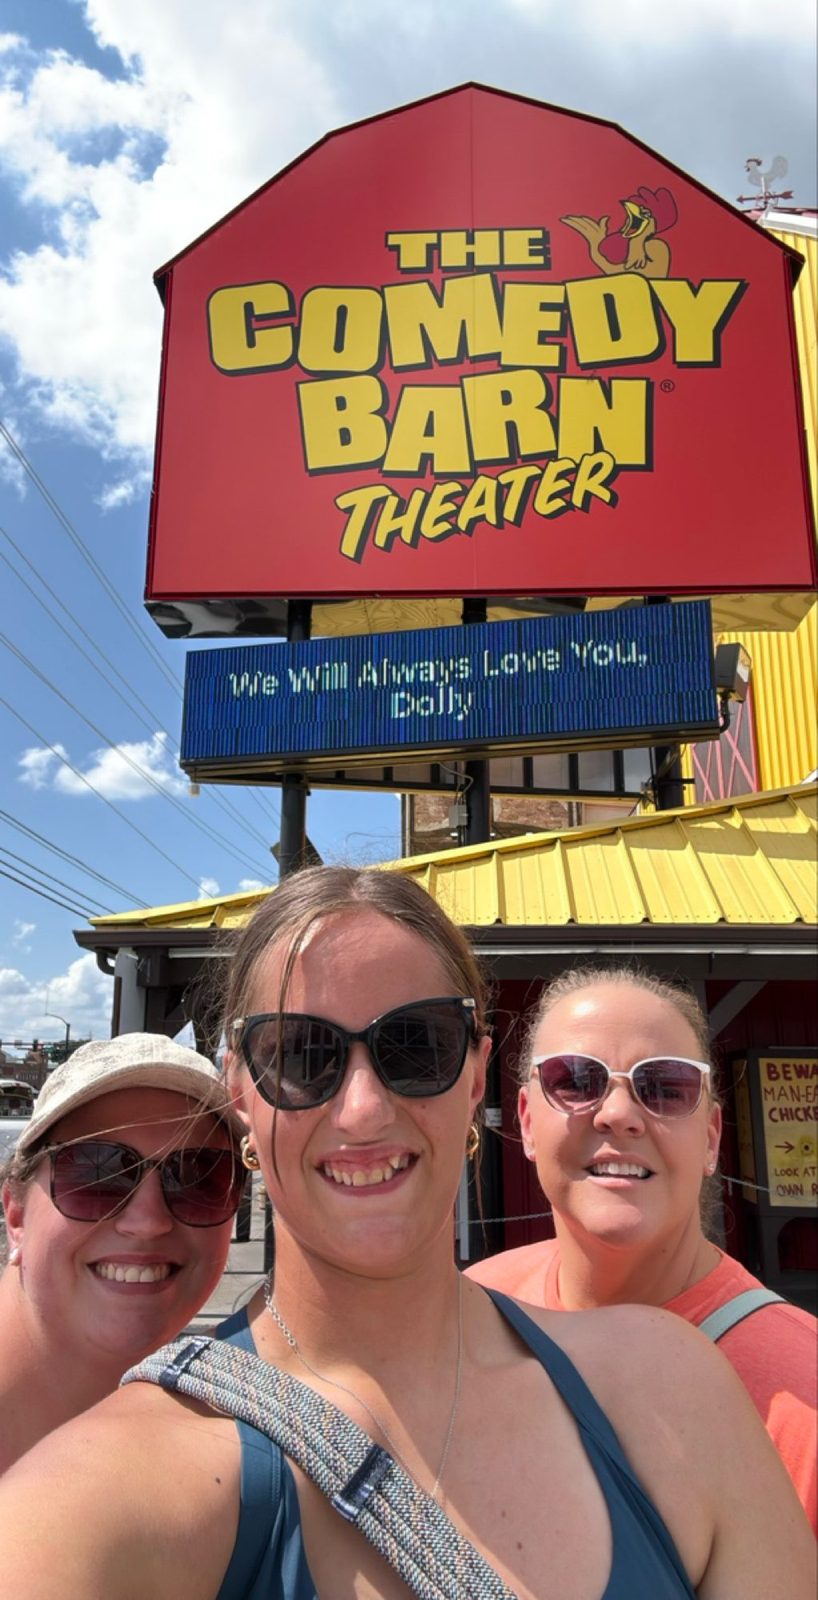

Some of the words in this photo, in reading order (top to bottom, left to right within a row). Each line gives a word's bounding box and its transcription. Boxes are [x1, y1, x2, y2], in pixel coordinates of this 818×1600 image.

[386, 228, 551, 274] THE
[208, 273, 750, 376] COMEDY
[296, 368, 654, 479] BARN
[335, 451, 619, 563] THEATER
[229, 671, 279, 697] We
[288, 661, 348, 693] Will
[358, 657, 471, 689] Always
[484, 648, 560, 677] Love
[571, 639, 648, 668] You,
[391, 686, 474, 721] Dolly
[774, 1167, 800, 1177] LOOK
[803, 1166, 817, 1177] AT
[776, 1183, 804, 1197] OWN
